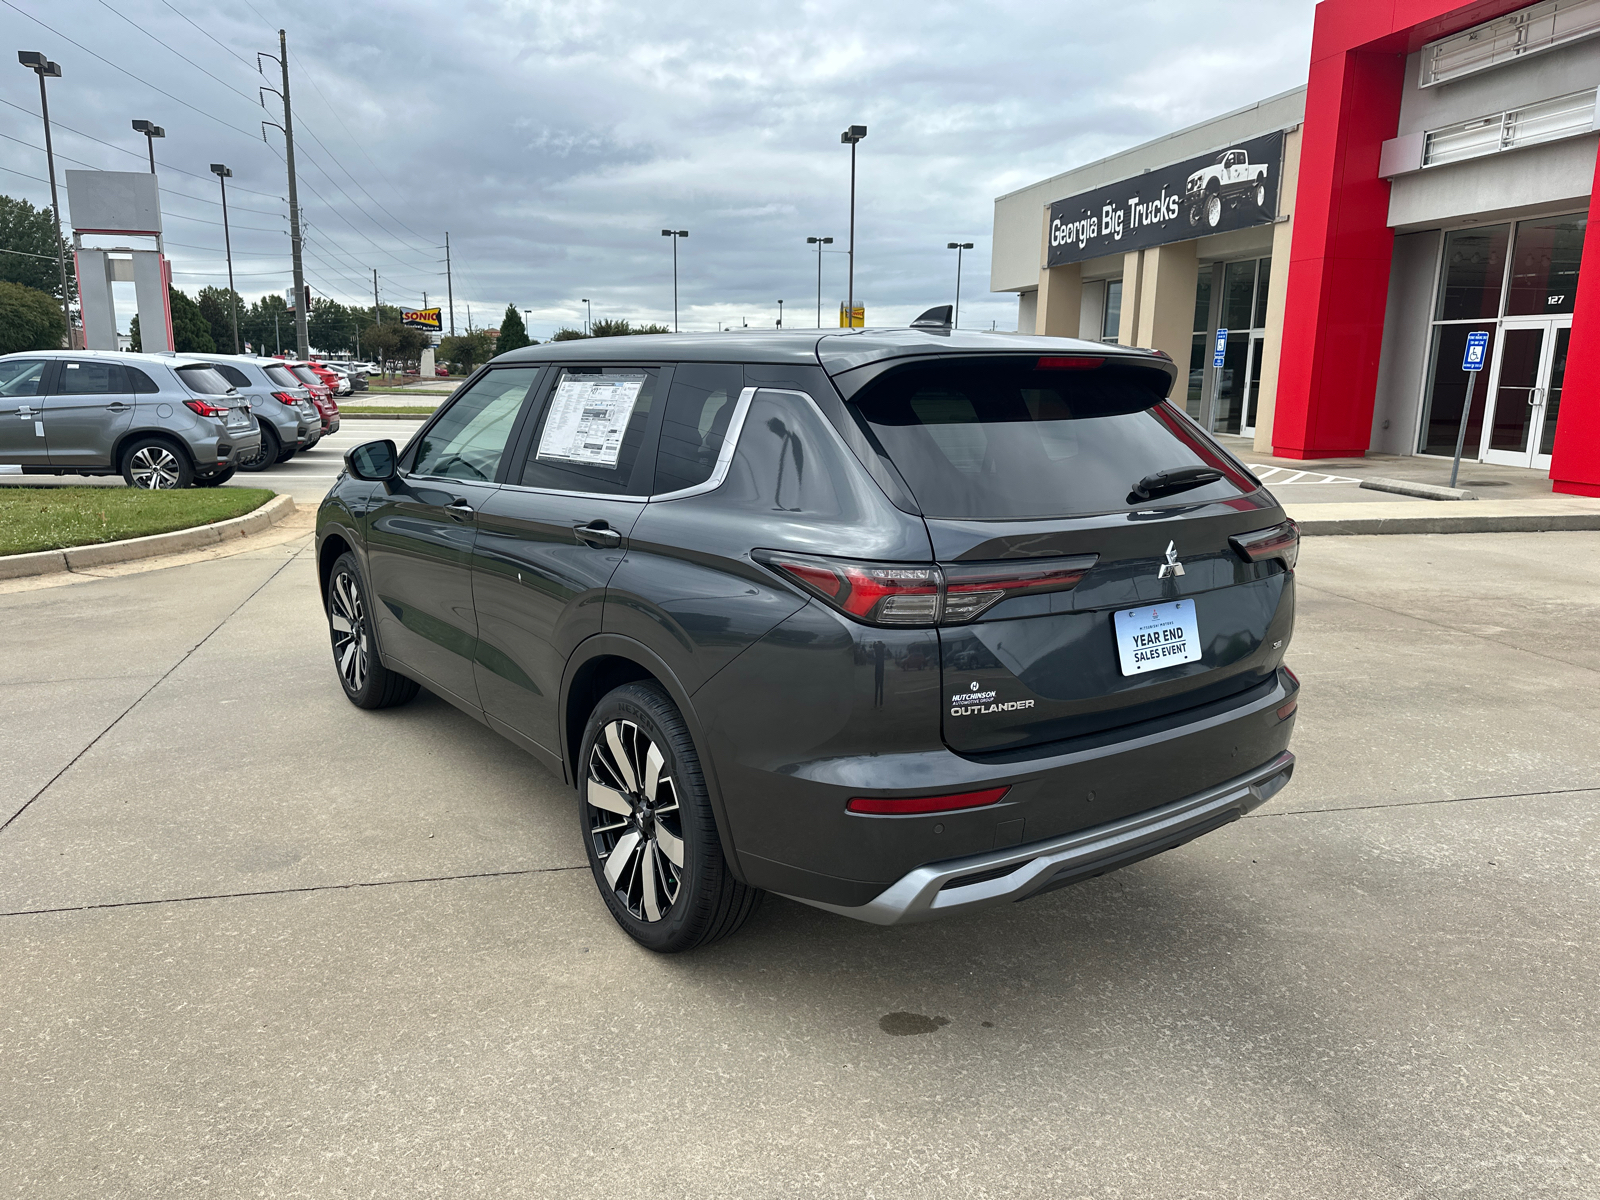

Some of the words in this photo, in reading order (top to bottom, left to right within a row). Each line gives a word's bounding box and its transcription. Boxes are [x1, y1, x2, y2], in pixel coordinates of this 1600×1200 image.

[1051, 210, 1098, 249] Georgia
[1102, 202, 1124, 241] Big
[1128, 190, 1179, 229] Trucks
[1547, 295, 1564, 305] 127
[404, 312, 437, 320] SONIC
[1132, 631, 1161, 648] YEAR
[1162, 627, 1184, 642] END
[1134, 648, 1160, 663] SALES
[1161, 643, 1187, 657] EVENT
[951, 690, 997, 702] HUTCHINSON
[618, 702, 654, 732] NEXEN
[950, 699, 1035, 717] OUTLANDER
